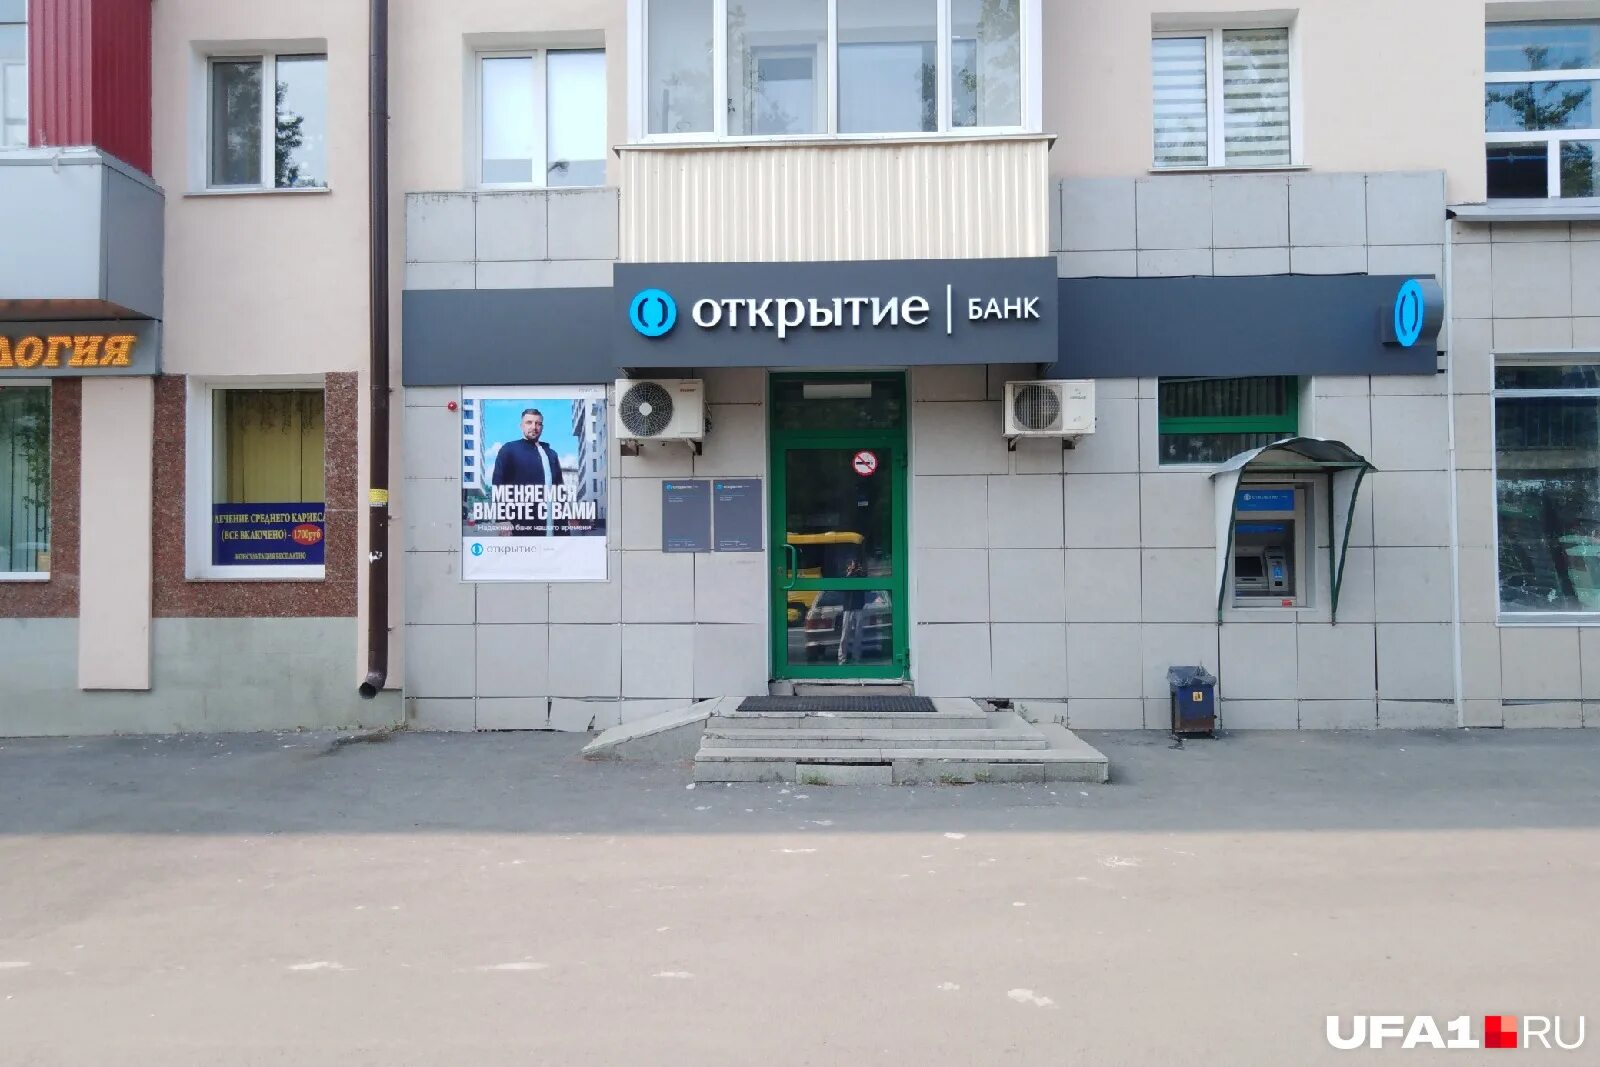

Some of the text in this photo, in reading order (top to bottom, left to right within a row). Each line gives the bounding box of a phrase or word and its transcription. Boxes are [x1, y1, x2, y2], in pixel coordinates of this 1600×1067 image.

[692, 294, 1041, 339] открытие БАНК
[492, 484, 578, 503] МЕНЯЕМСЯ
[250, 512, 291, 525] СРЕДНЕГО
[473, 502, 597, 520] ВМЕСТЕ С ВАМИ
